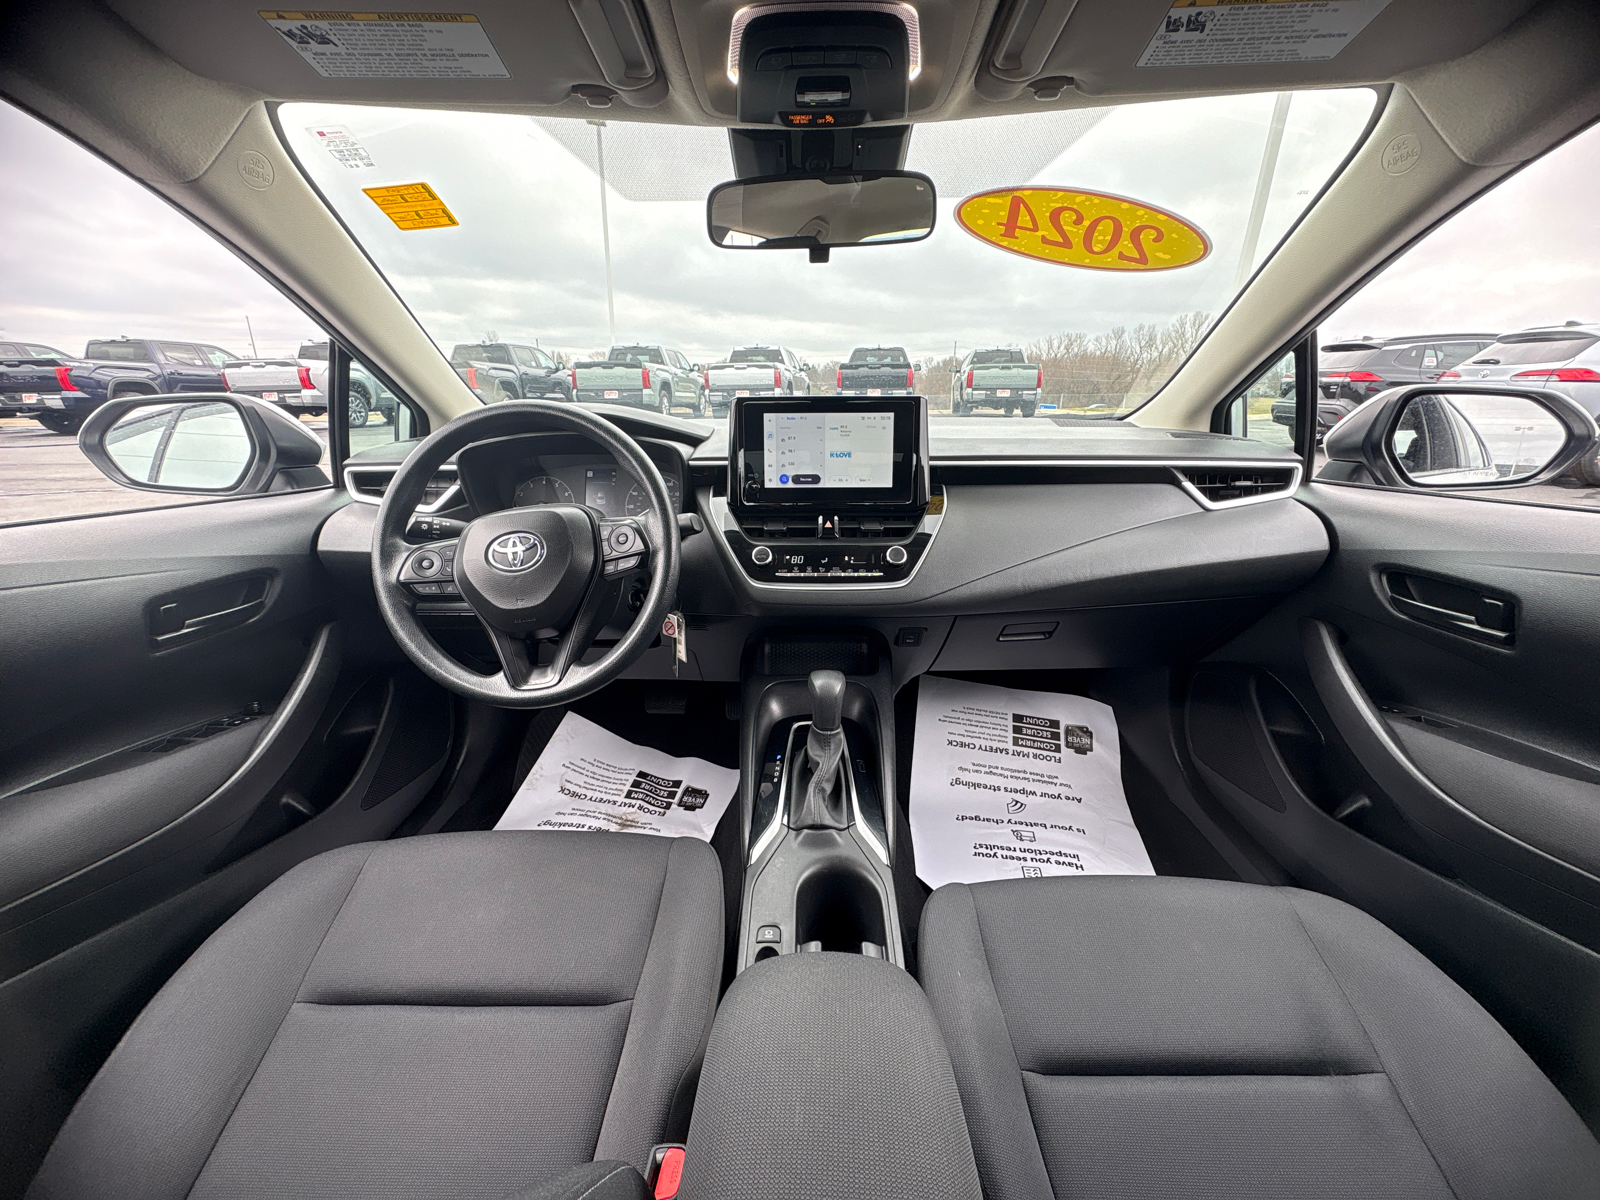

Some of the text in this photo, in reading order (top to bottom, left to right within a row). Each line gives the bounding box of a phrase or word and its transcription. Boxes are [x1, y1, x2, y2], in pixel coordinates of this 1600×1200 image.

[302, 12, 463, 21] WARNING AVERTISSEMENT
[1387, 148, 1419, 169] AIRBAG
[242, 165, 270, 184] AIRBAG
[790, 555, 804, 564] 80
[1022, 716, 1050, 727] COUNT
[1021, 727, 1051, 738] SECURE
[1018, 738, 1056, 751] CONFIRM
[1067, 735, 1090, 745] NEVER
[947, 739, 1062, 764] FLOOR MAT SAFETY CHECK
[983, 770, 1009, 779] Manager
[1001, 766, 1028, 776] questions
[646, 774, 673, 787] COUNT
[1010, 775, 1030, 783] Service
[1032, 778, 1058, 787] Assistant
[558, 785, 587, 800] CHECK
[639, 782, 669, 798] SECURE
[950, 778, 1082, 804] Are your wipers streaking?
[587, 795, 617, 806] SAFETY
[618, 801, 637, 809] MAT
[631, 791, 667, 808] CONFIRM
[637, 802, 666, 817] FLOOR
[955, 815, 1004, 825] charged?
[1006, 818, 1047, 829] battery
[1050, 824, 1074, 833] your
[973, 843, 1016, 852] results?
[973, 851, 1084, 871] Have you seen your
[670, 1160, 681, 1185] PRESS
